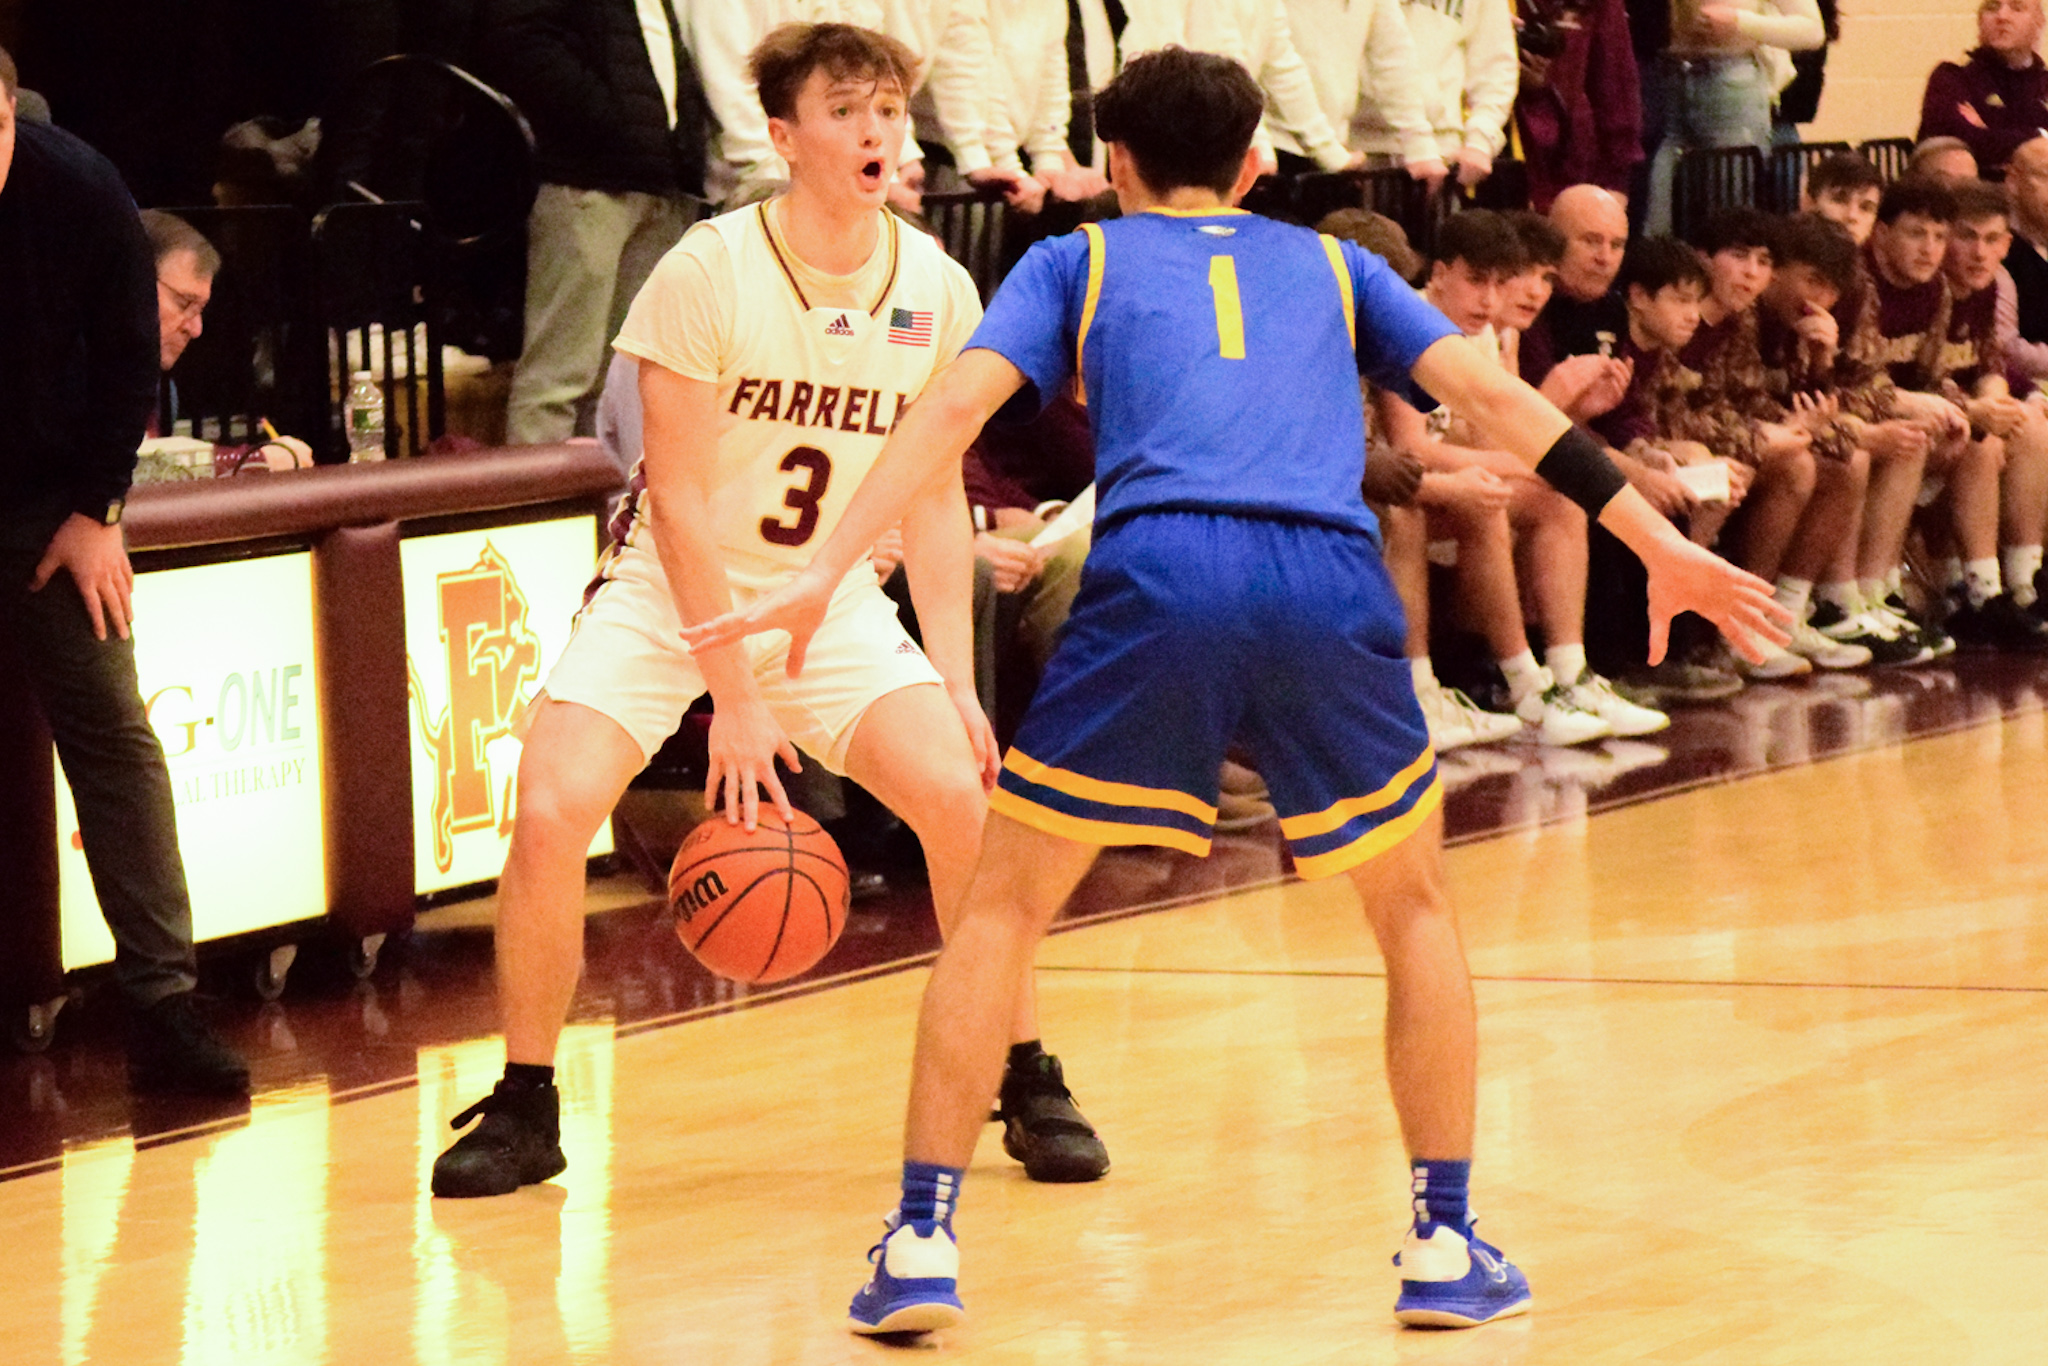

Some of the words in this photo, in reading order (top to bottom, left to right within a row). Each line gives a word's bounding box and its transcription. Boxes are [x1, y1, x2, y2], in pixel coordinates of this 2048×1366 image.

[824, 326, 855, 337] adidas
[1208, 254, 1247, 360] 1
[757, 443, 834, 547] 3
[209, 757, 306, 799] THERAPY
